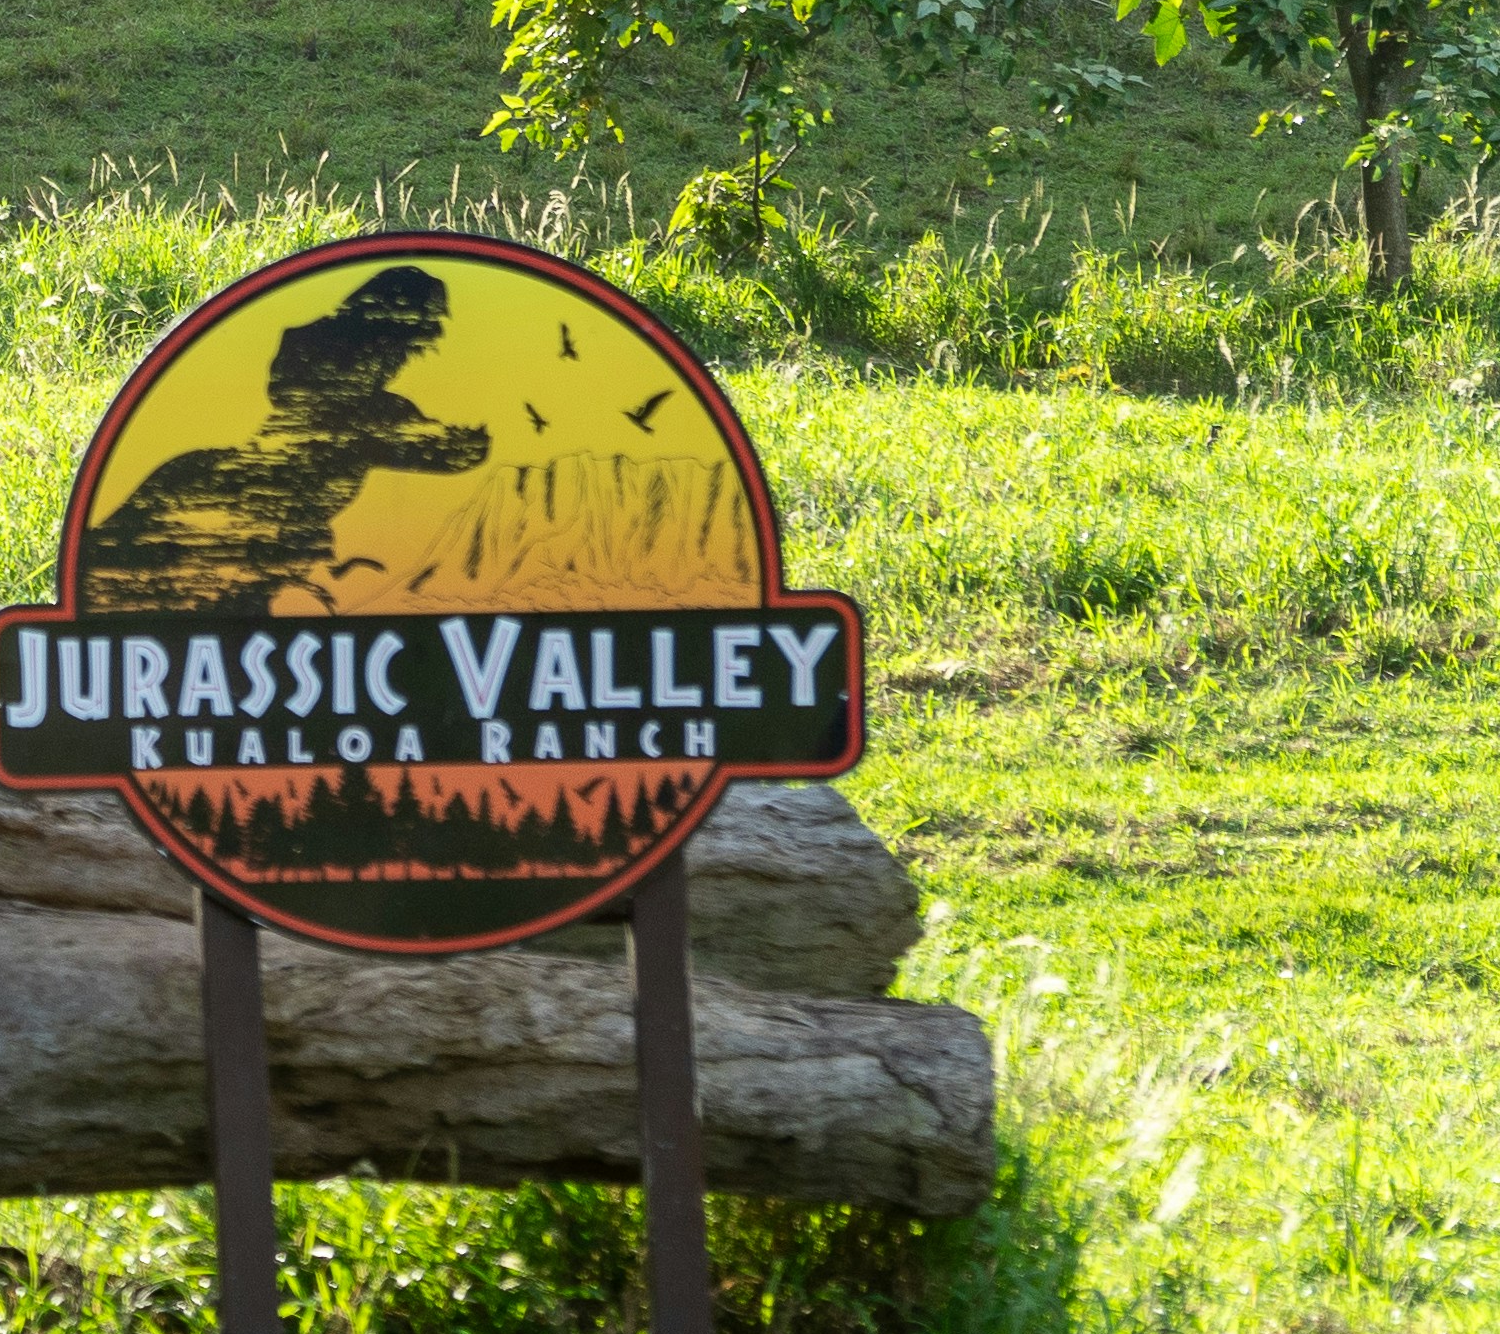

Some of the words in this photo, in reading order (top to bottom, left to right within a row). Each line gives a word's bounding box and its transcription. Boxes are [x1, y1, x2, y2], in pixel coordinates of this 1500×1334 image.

[6, 627, 408, 729] JURASSIC
[439, 616, 839, 719] VALLEY
[131, 724, 425, 770] KUALOA
[480, 719, 716, 764] RANCH
